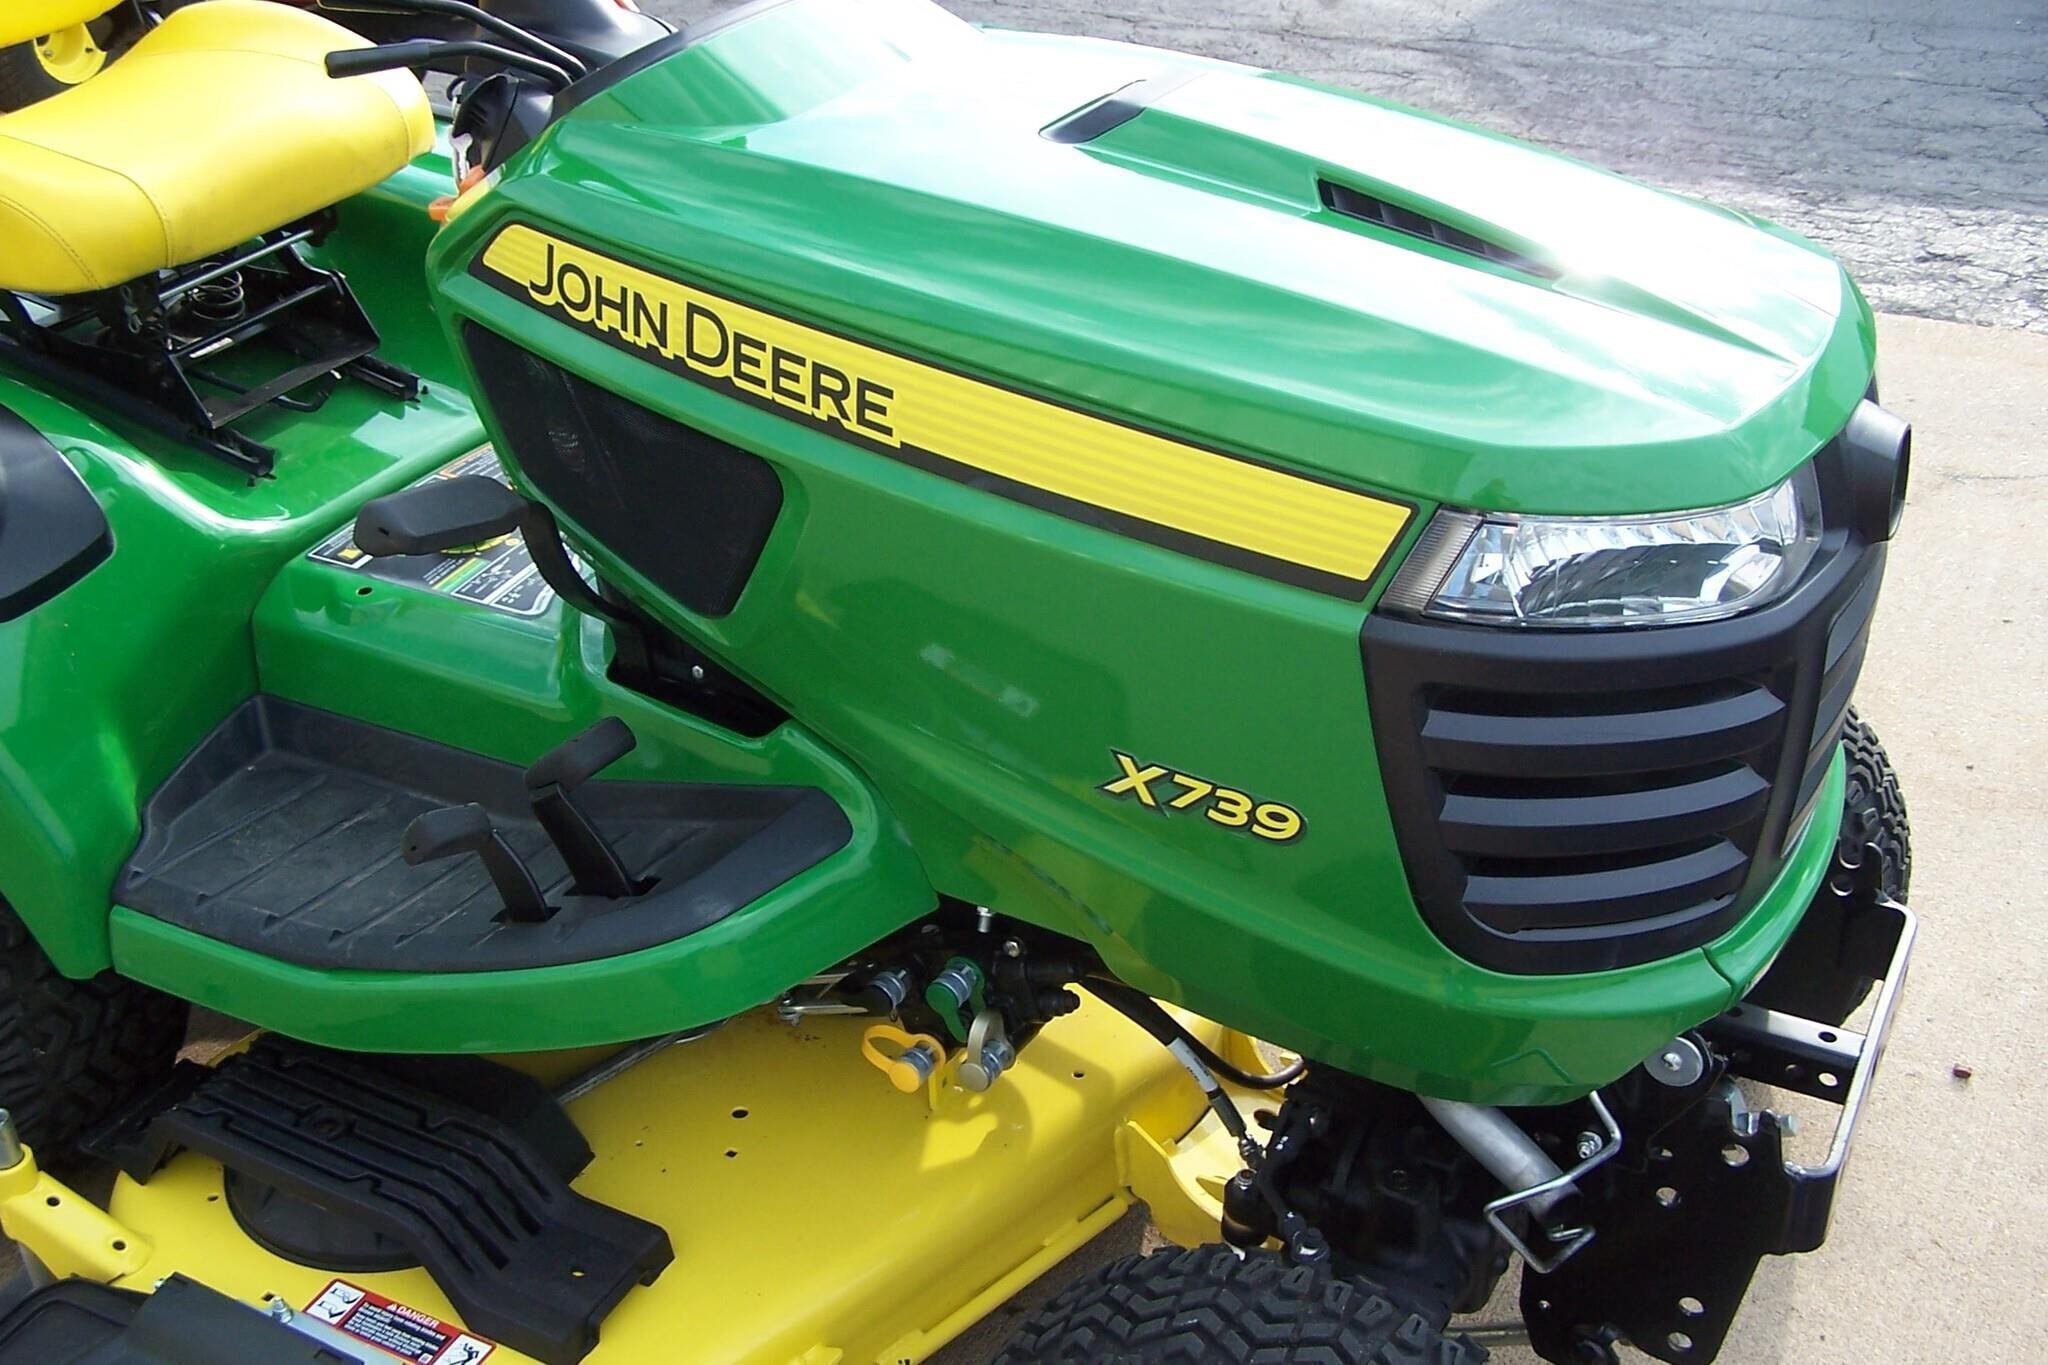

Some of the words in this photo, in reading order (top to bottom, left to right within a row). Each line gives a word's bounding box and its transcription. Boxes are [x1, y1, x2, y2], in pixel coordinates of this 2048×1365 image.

[529, 244, 667, 349] JOHN
[686, 301, 895, 437] DEERE
[1100, 751, 1302, 841] X739
[397, 1305, 440, 1329] DANGER
